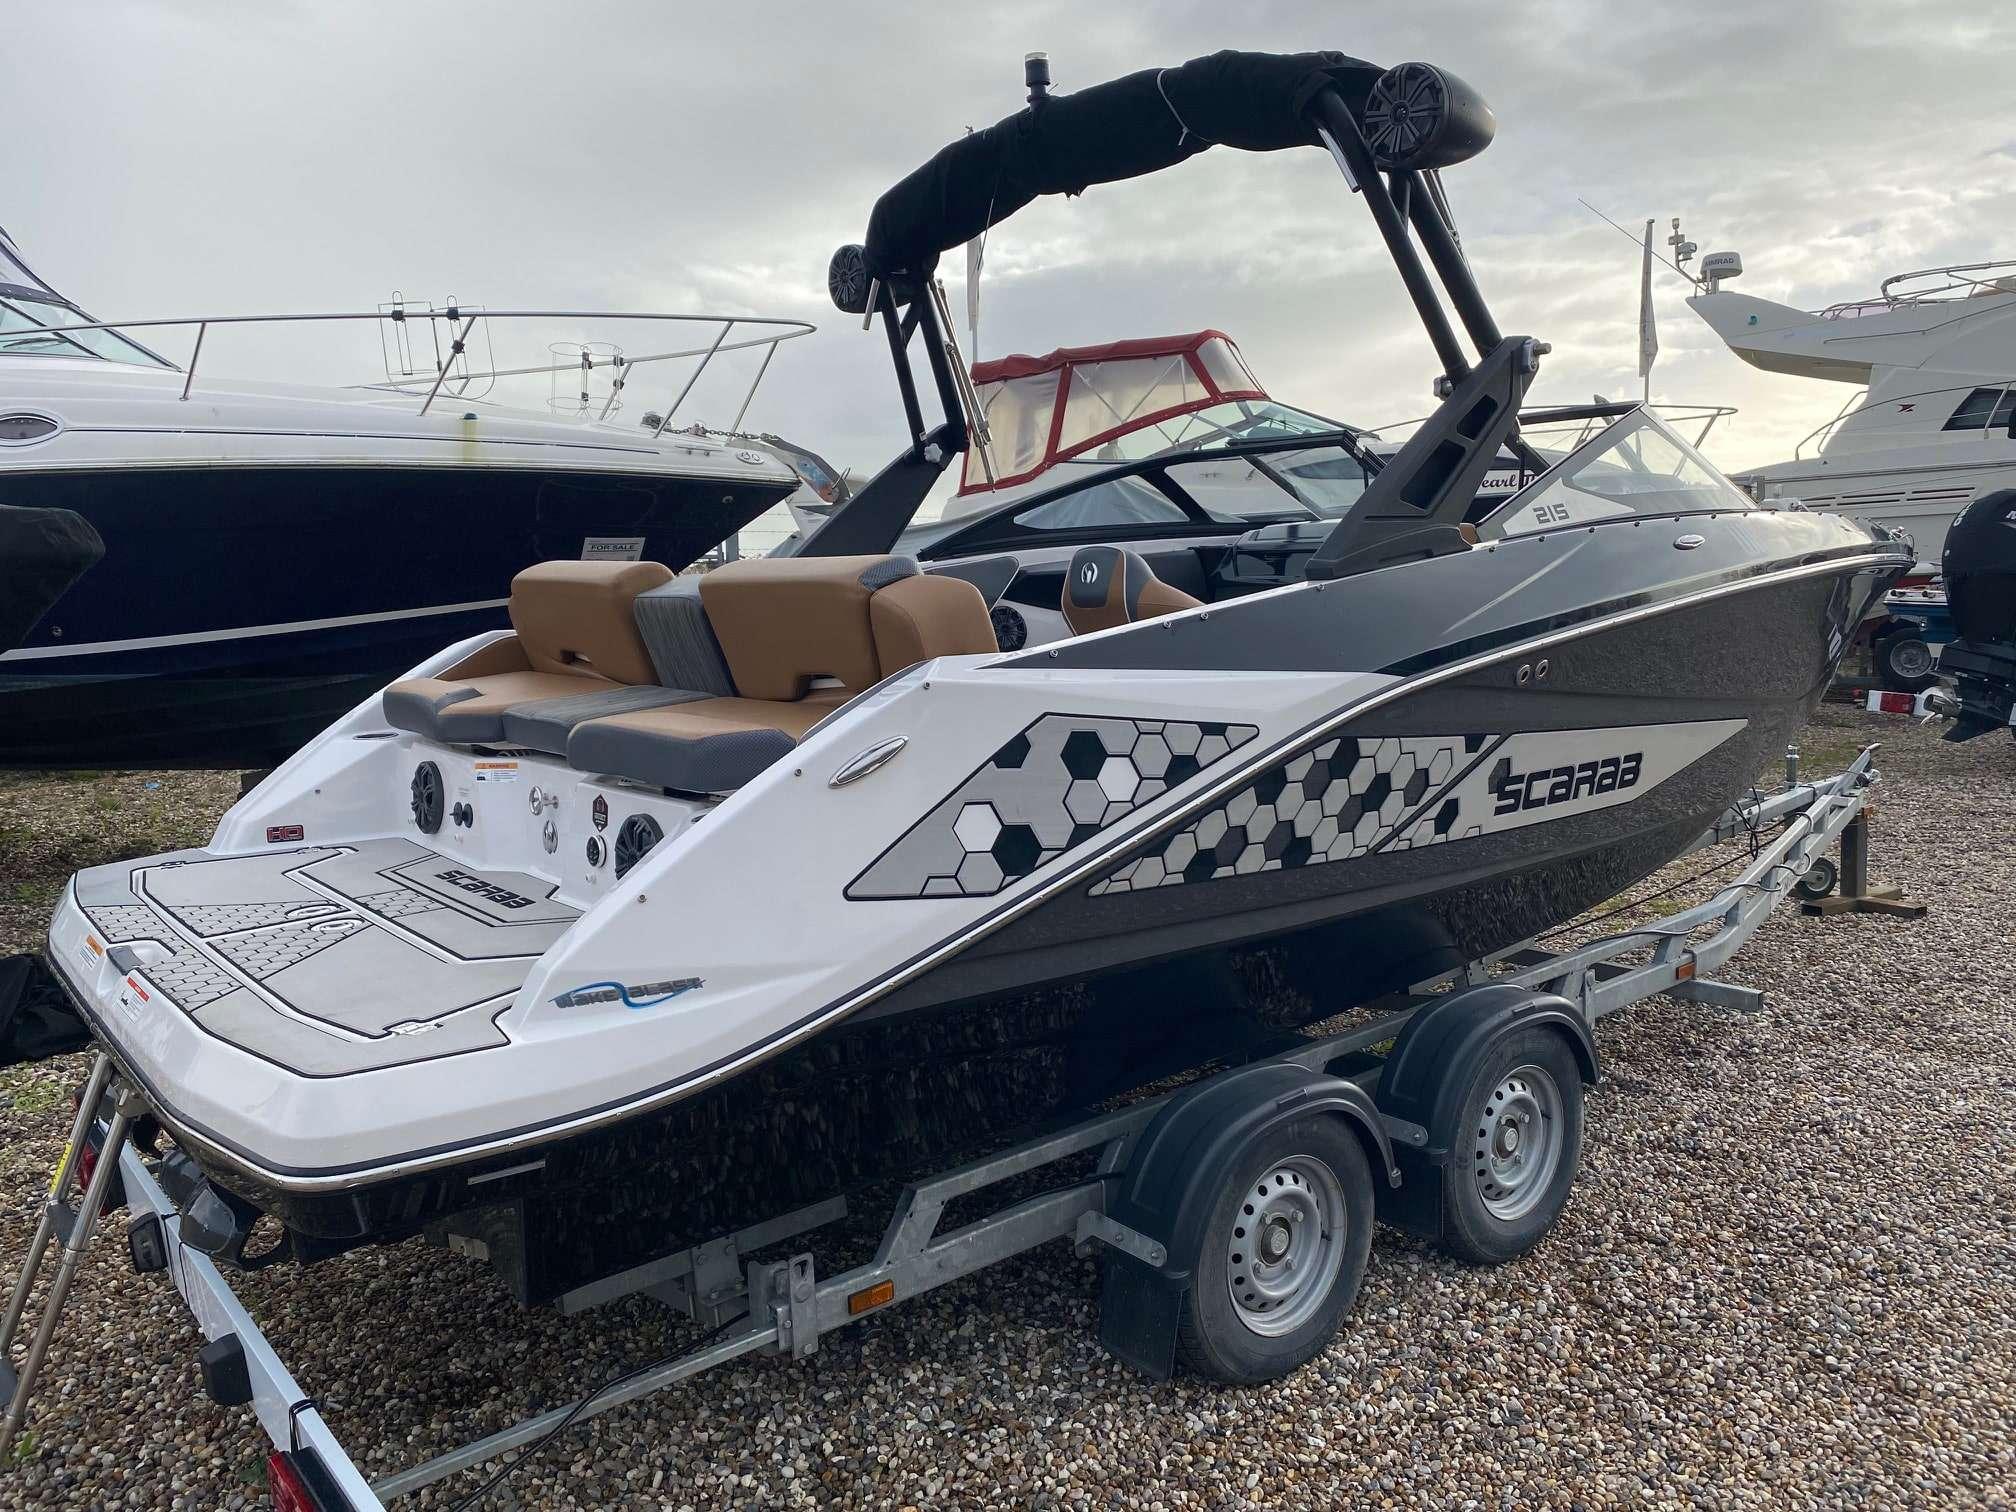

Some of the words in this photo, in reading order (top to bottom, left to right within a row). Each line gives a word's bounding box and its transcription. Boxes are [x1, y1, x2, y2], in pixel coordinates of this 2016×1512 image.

[1481, 473, 1516, 488] earl
[1532, 502, 1570, 525] 215
[1490, 752, 1643, 817] SCARAB
[433, 869, 537, 909] SCARAB
